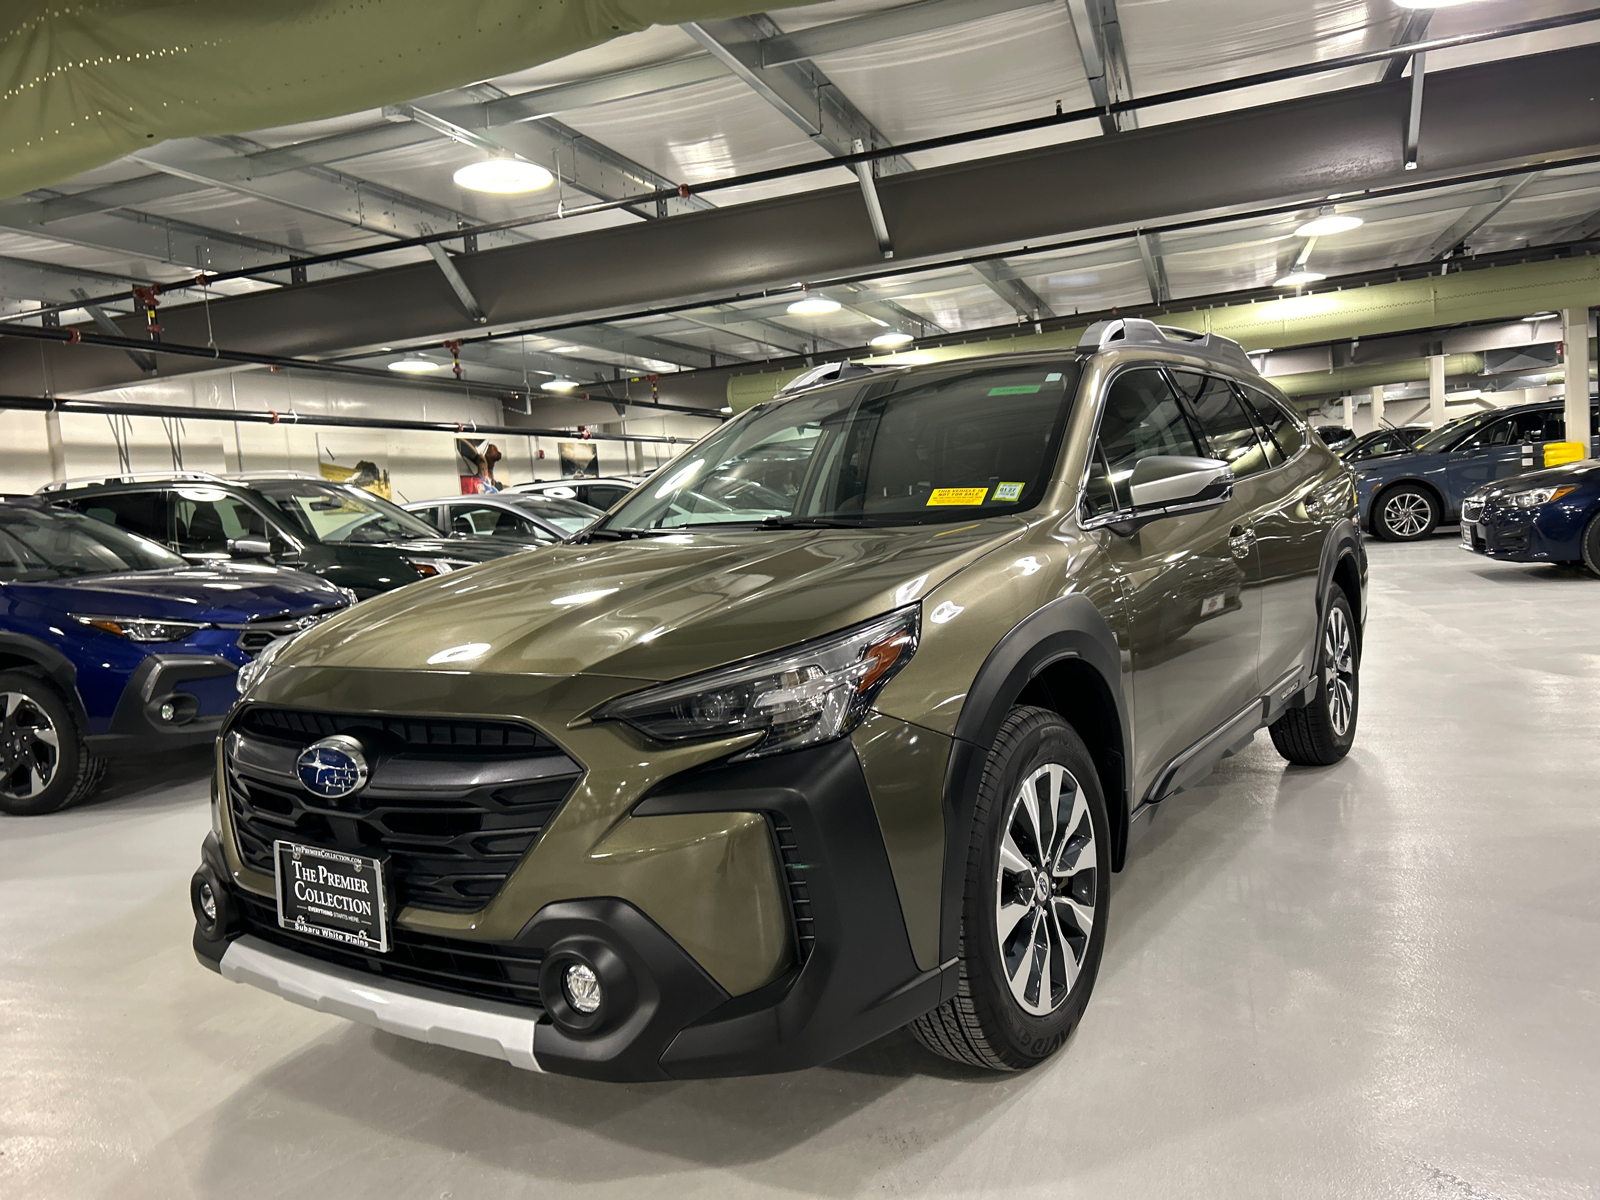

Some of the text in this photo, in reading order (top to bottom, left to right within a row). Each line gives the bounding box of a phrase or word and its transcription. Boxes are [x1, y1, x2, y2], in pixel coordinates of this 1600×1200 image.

[317, 865, 370, 894] PREMIER
[294, 881, 372, 916] COLLECTION
[294, 923, 369, 948] Subaru White Plains
